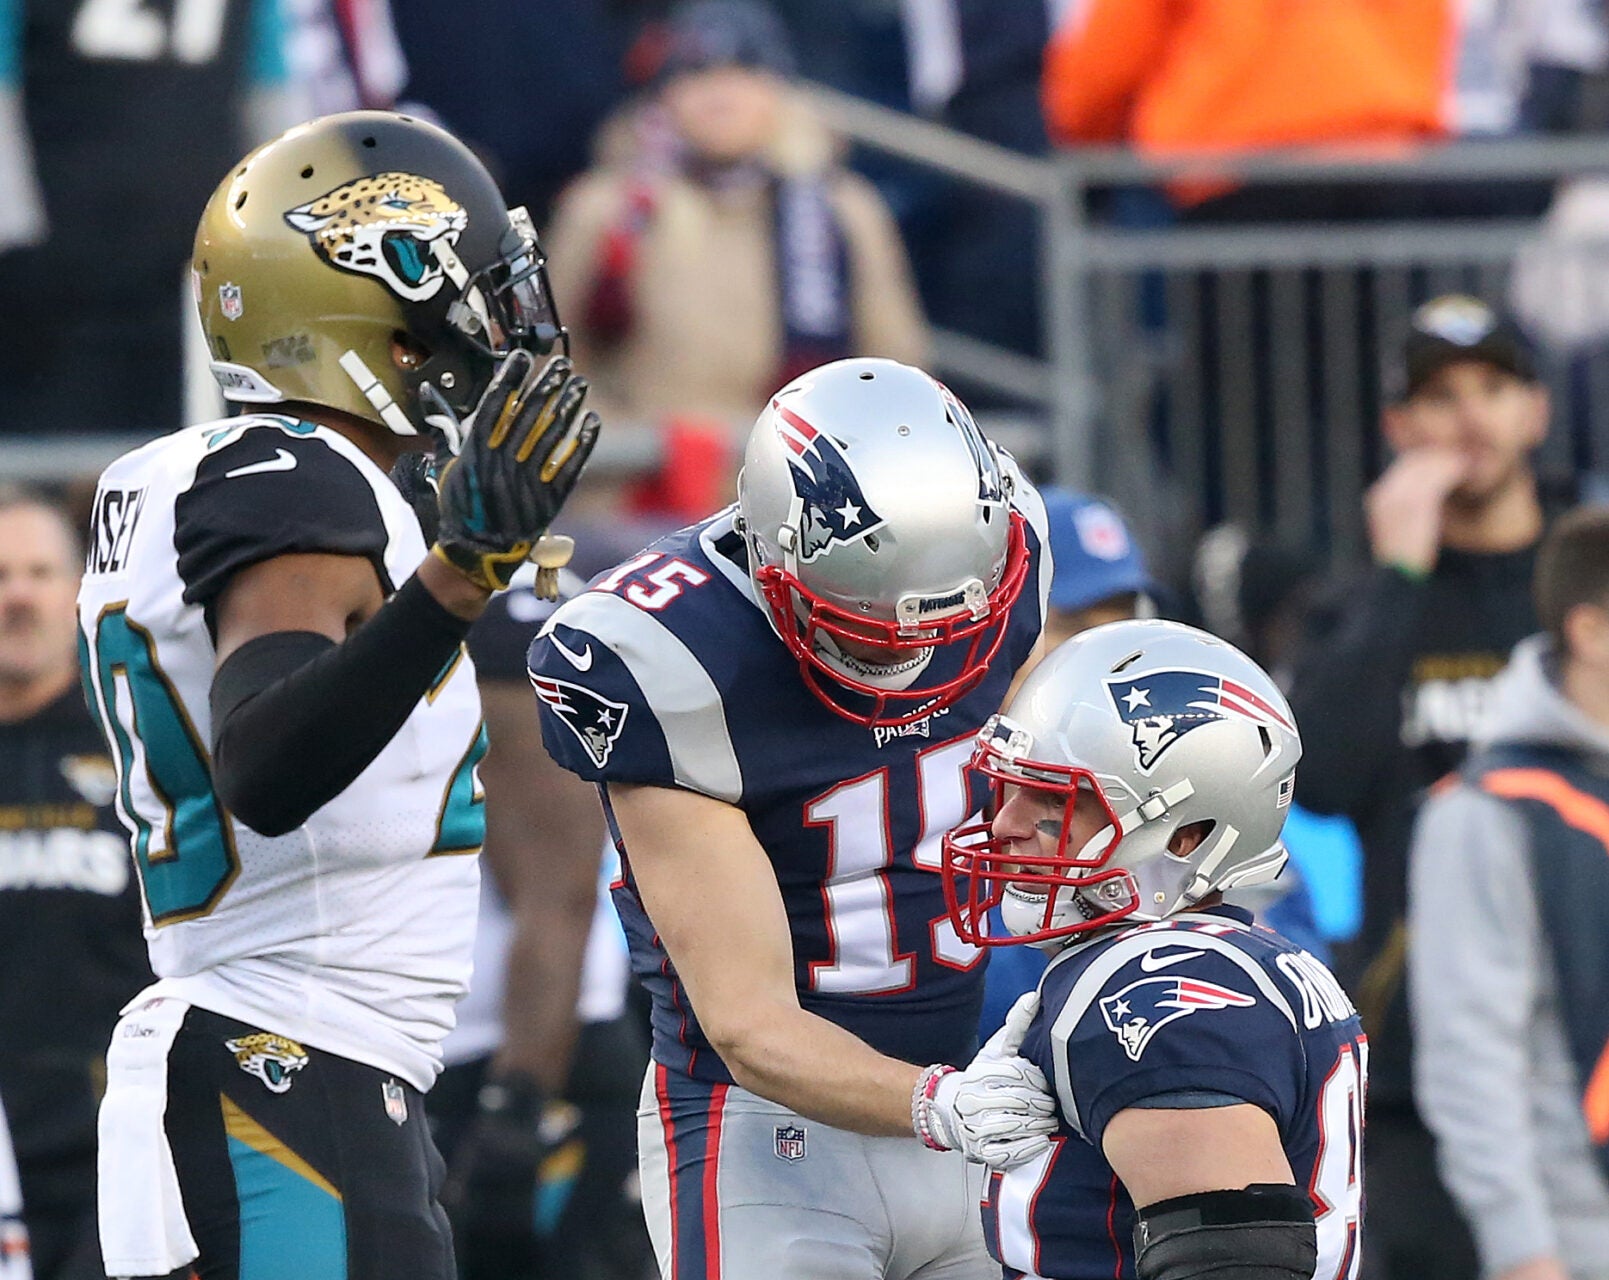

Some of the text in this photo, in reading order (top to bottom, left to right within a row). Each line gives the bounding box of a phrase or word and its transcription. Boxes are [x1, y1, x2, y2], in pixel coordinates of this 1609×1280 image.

[588, 551, 713, 613] 15
[919, 591, 966, 614] PATRIOTS
[75, 599, 243, 930] 0
[802, 728, 992, 997] 15
